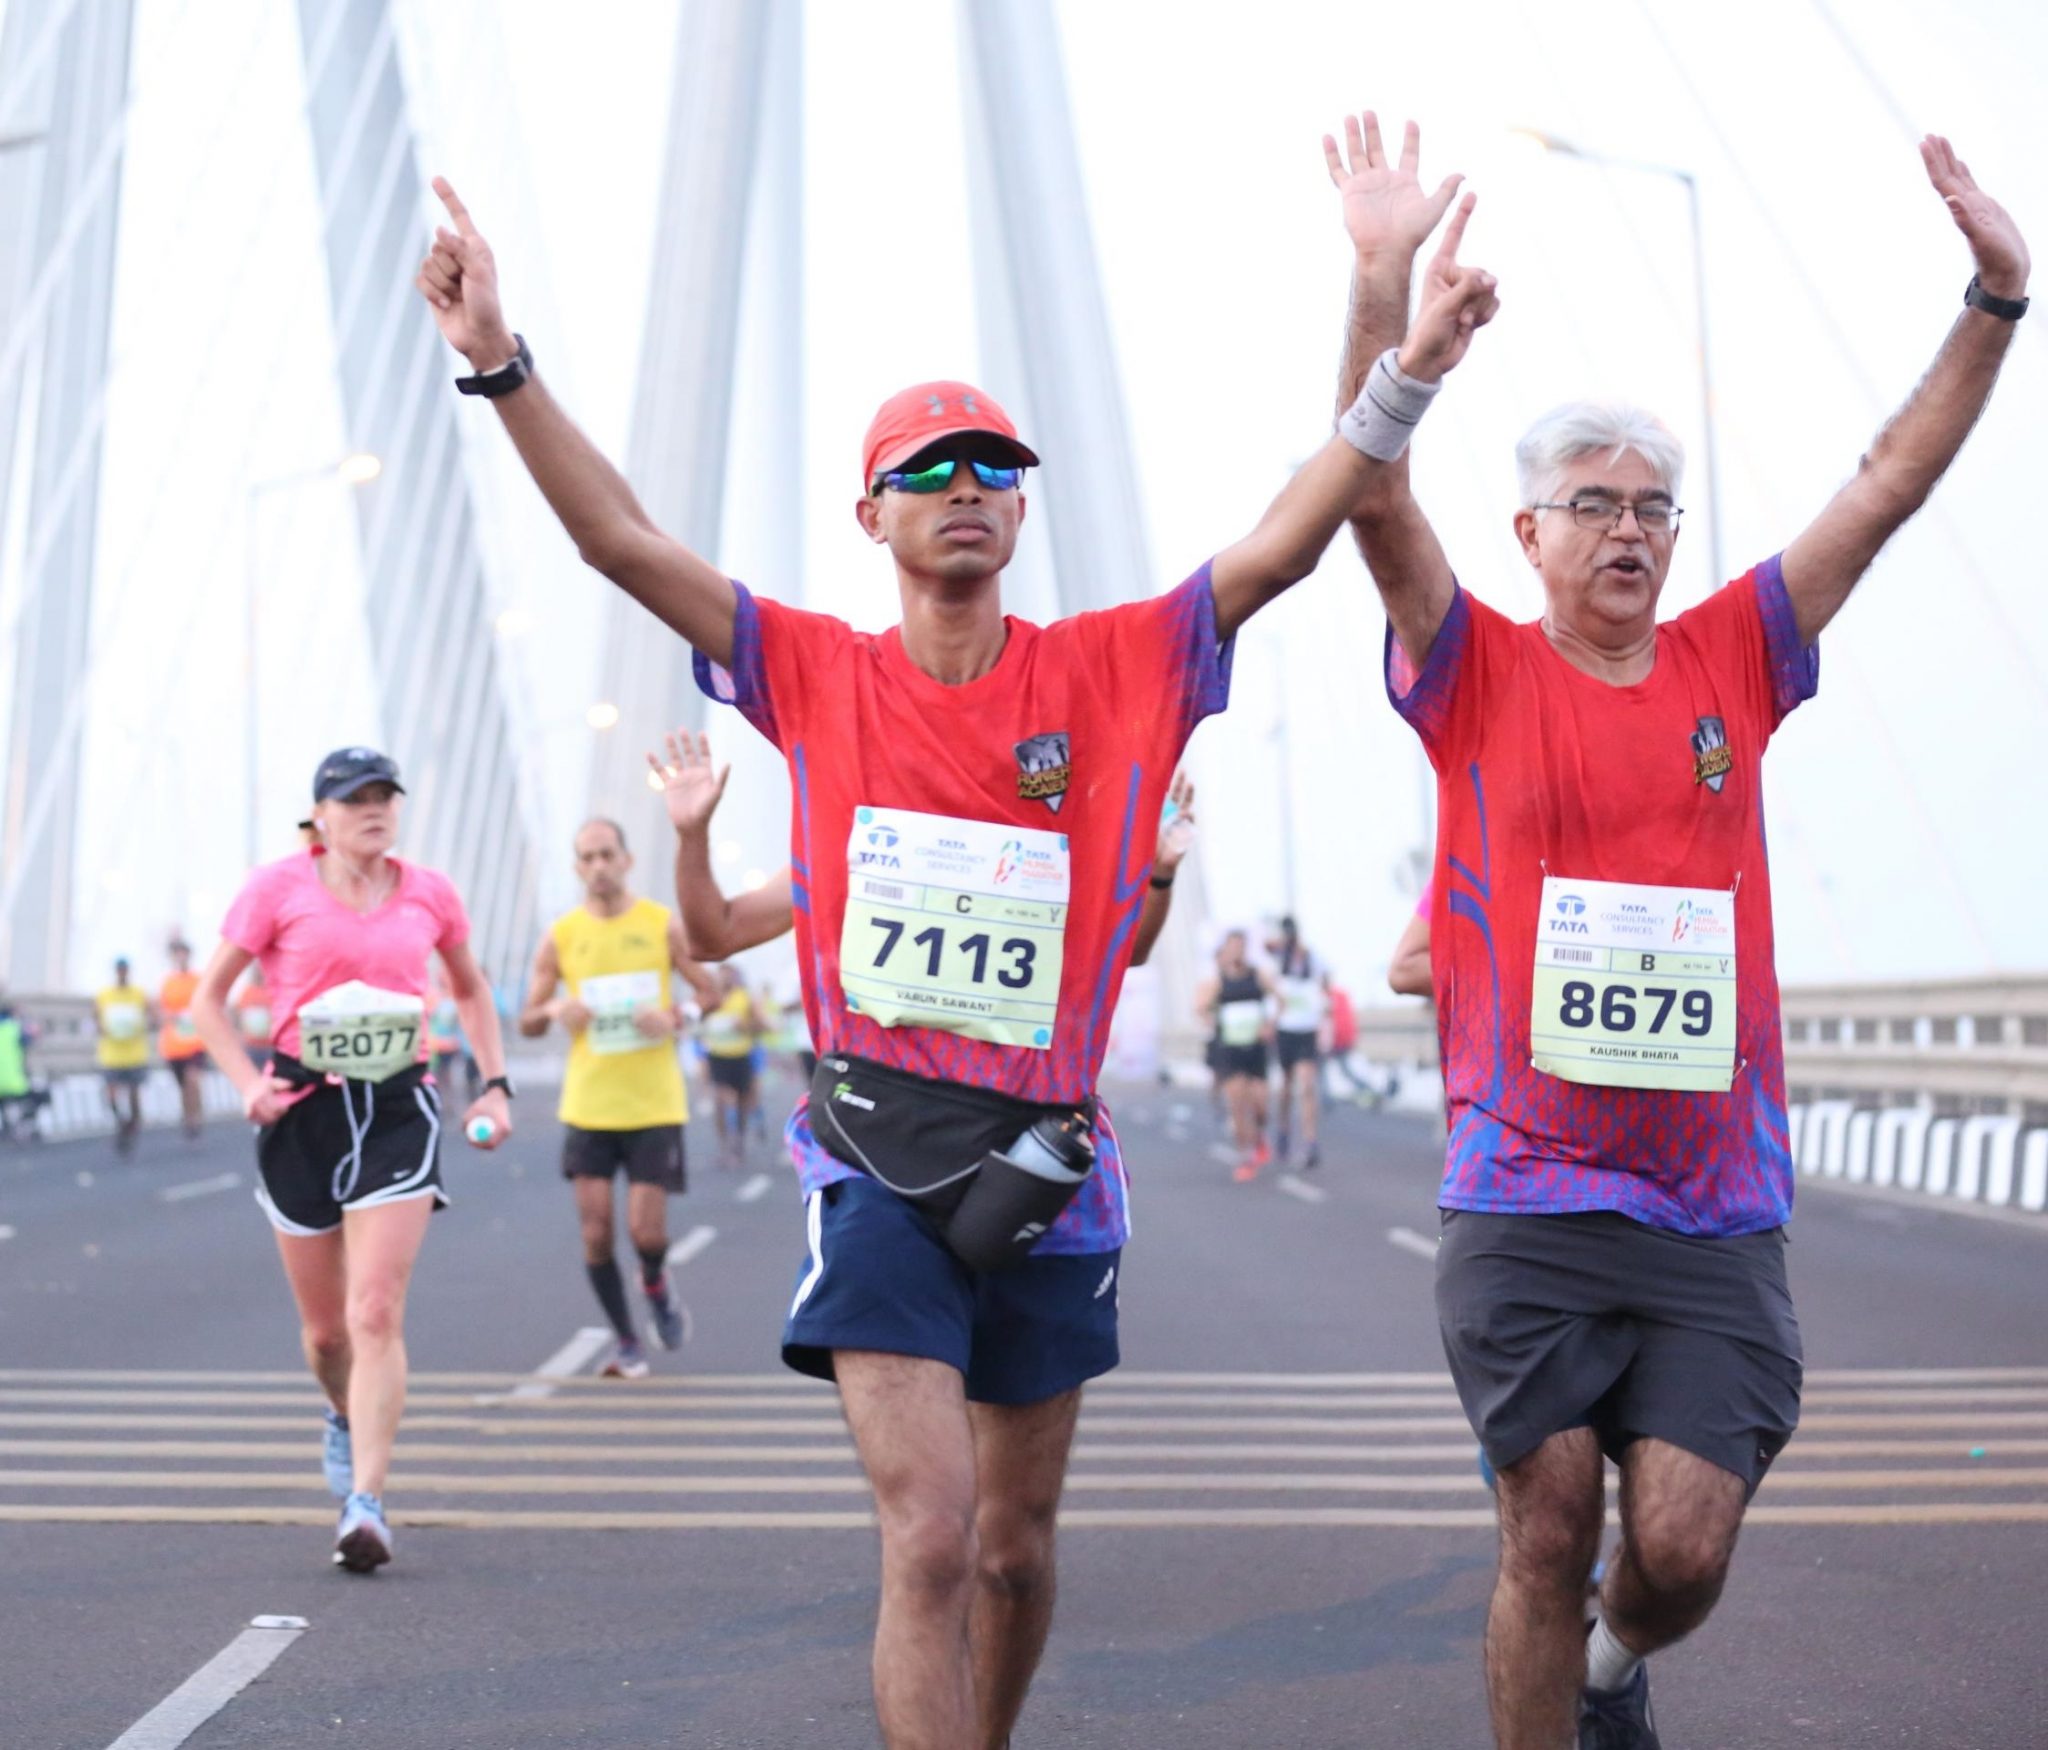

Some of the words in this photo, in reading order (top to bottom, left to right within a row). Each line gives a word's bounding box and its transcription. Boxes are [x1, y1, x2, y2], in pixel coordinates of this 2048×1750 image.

[938, 839, 967, 849] TATA
[859, 852, 900, 868] TATA
[956, 895, 972, 913] C
[1621, 904, 1648, 913] TATA
[1549, 919, 1589, 934] TATA
[1600, 912, 1665, 925] CONSULTANCY
[871, 917, 1036, 988] 7113
[1640, 954, 1655, 971] B
[897, 990, 937, 1004] VARUN
[942, 997, 993, 1012] SAWANT
[1559, 981, 1713, 1036] 8679
[308, 1027, 416, 1058] 12077
[1590, 1046, 1638, 1058] KAUSHIK
[1641, 1050, 1679, 1061] BHATIA
